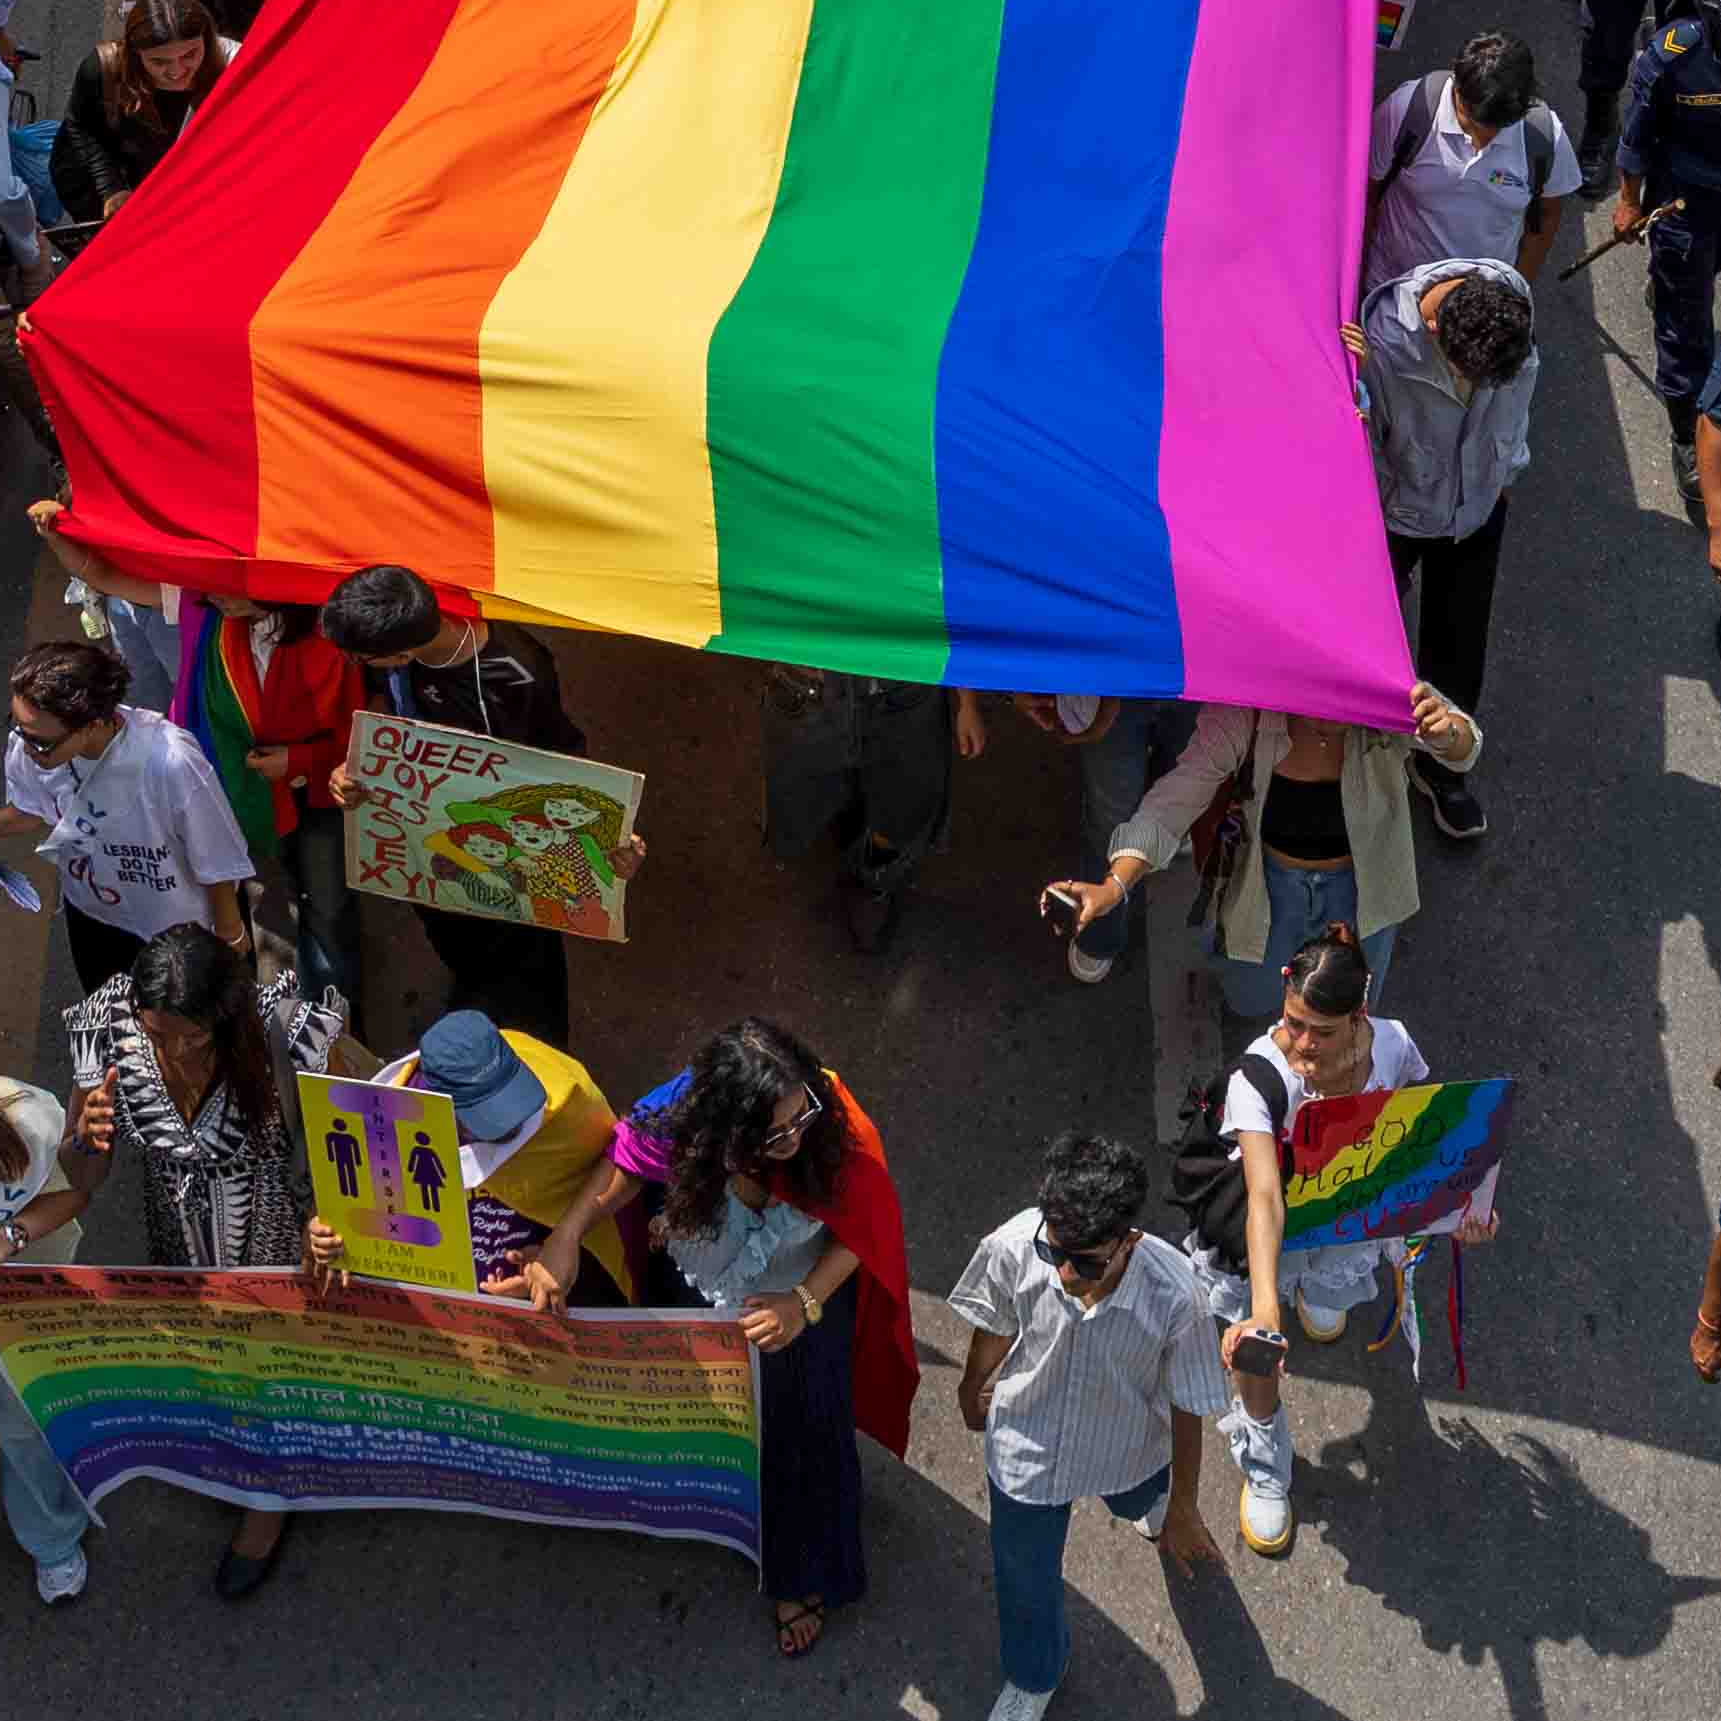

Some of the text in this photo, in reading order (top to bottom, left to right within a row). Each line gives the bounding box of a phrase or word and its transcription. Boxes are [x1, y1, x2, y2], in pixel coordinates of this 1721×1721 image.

[372, 726, 510, 782] QUEER
[361, 752, 451, 803] JOY
[117, 869, 177, 892] BETTER
[119, 858, 161, 877] DO IT
[272, 1420, 354, 1438] Nepal
[362, 1423, 441, 1444] Pride
[447, 1434, 553, 1465] Parade
